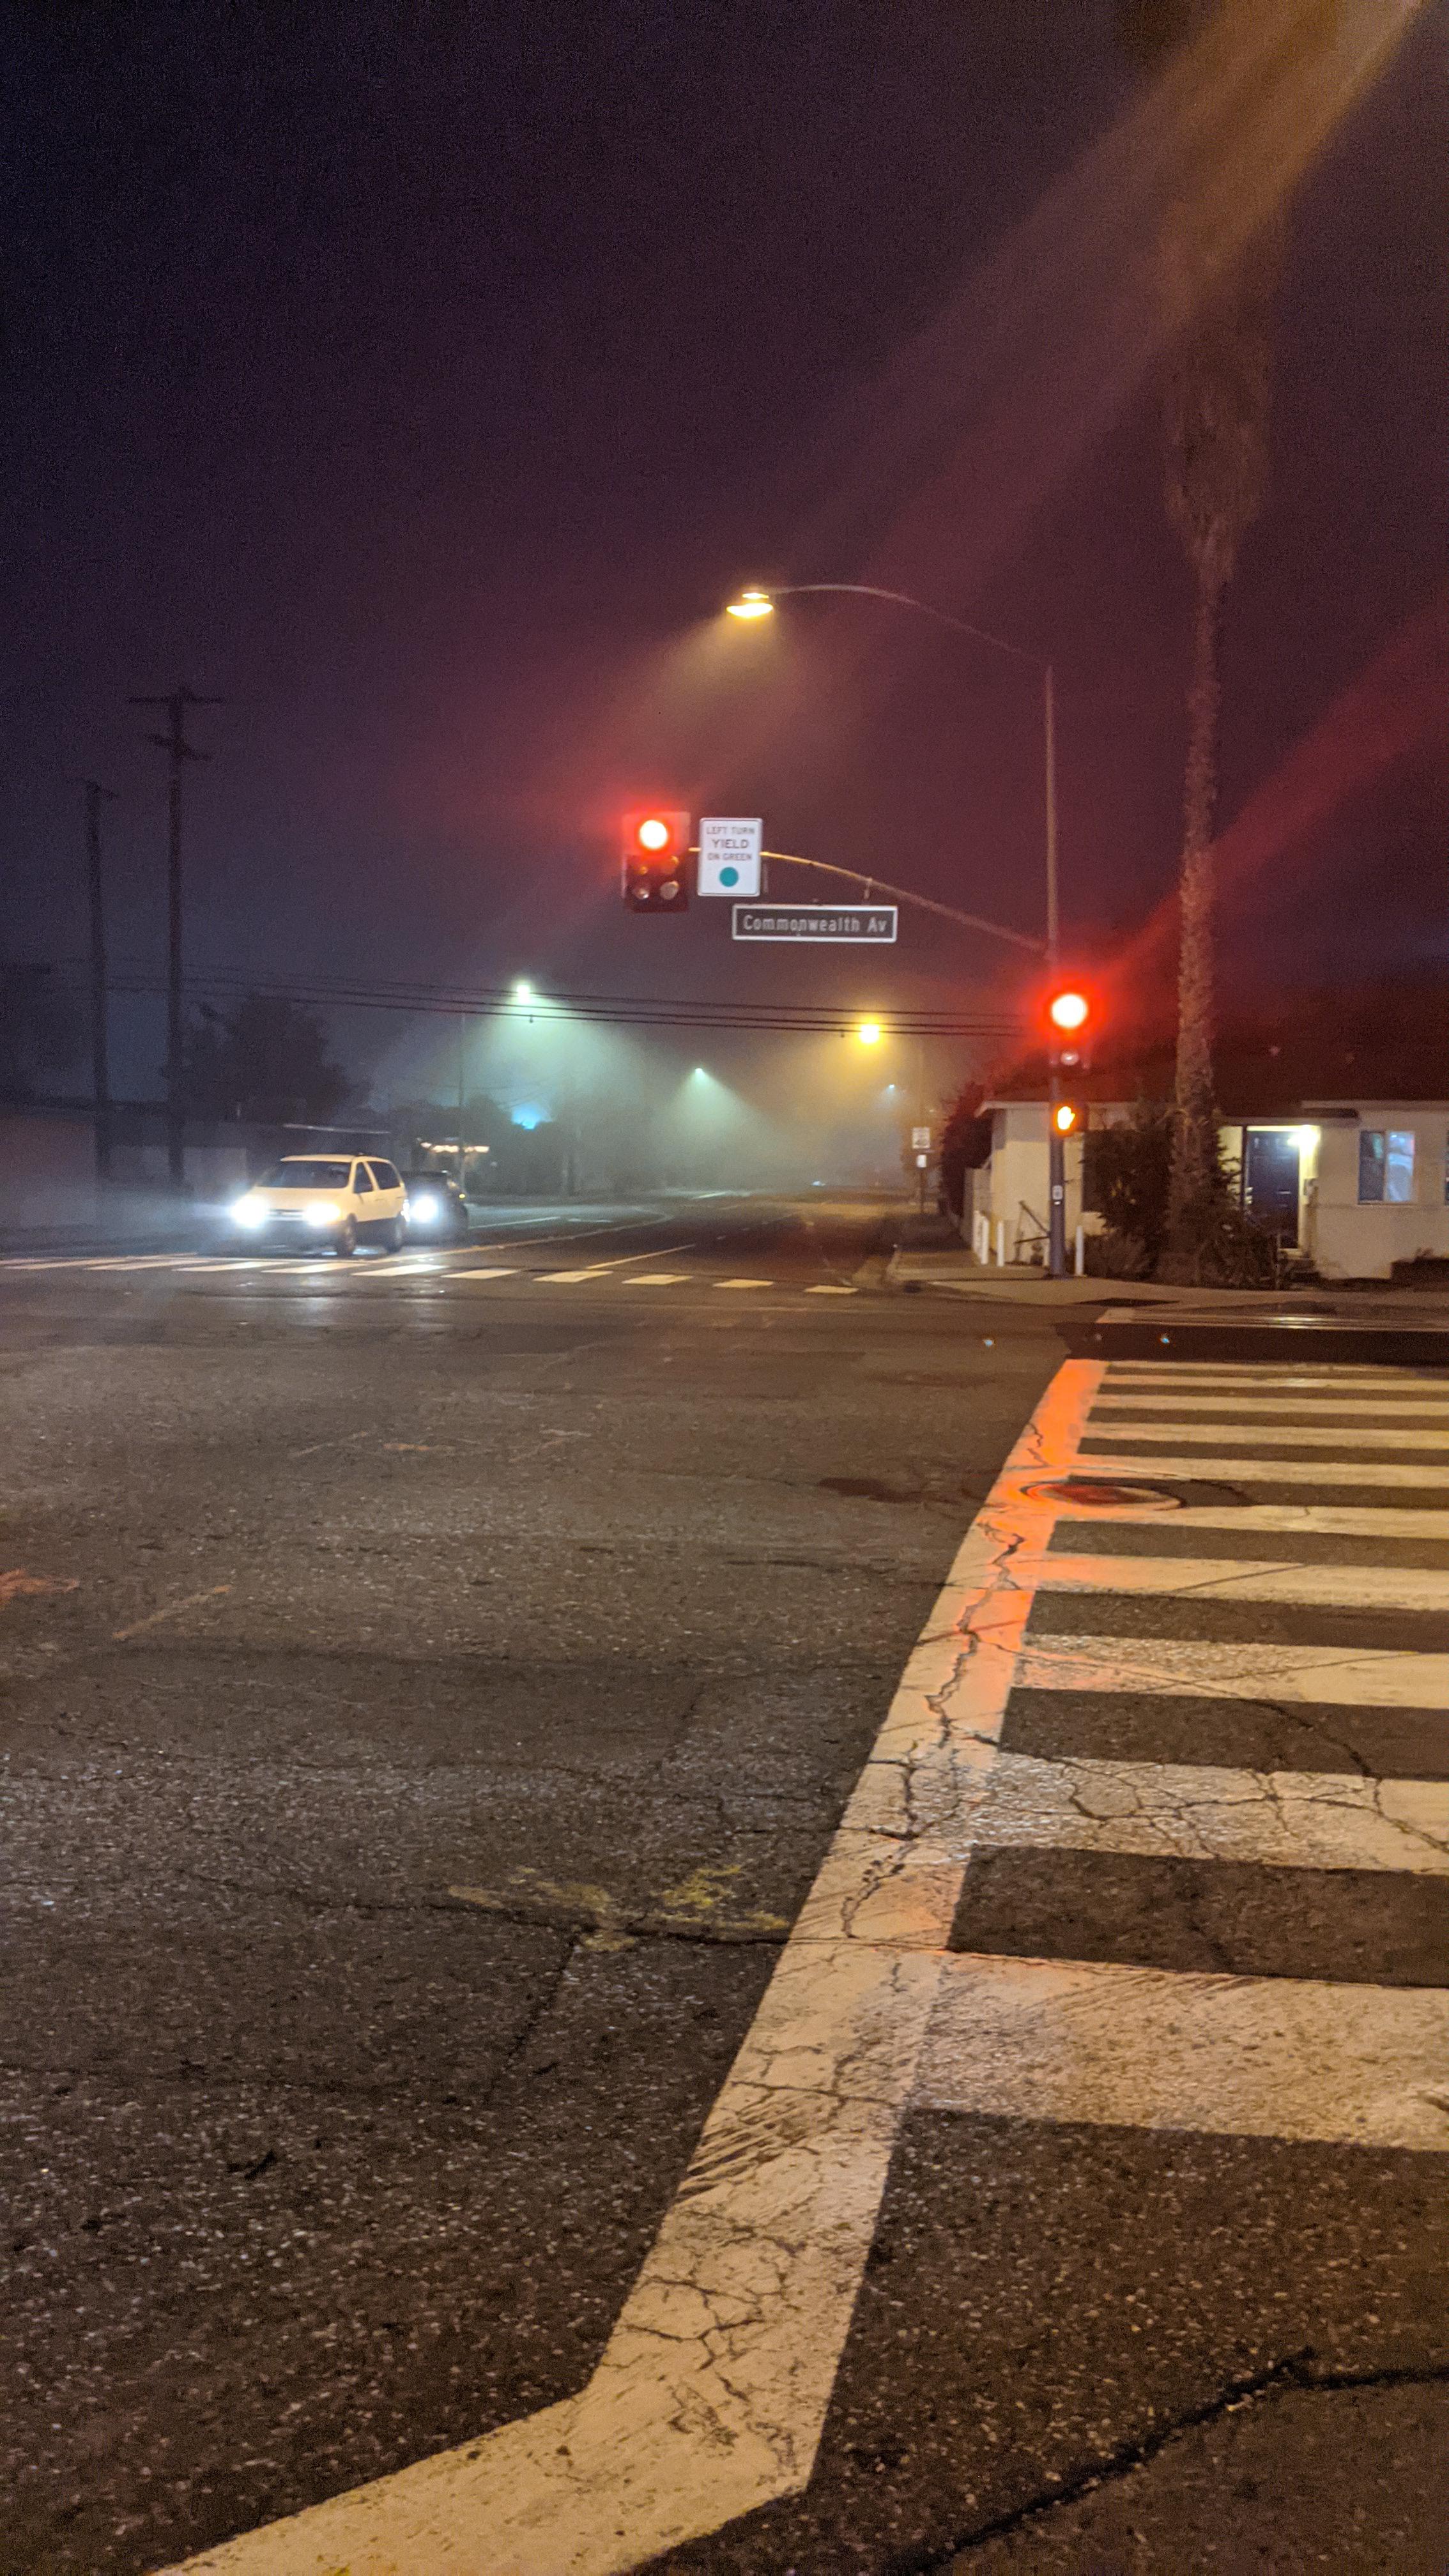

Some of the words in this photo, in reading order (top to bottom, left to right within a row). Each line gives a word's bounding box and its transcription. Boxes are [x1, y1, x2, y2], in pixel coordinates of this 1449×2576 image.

[707, 826, 726, 835] LEFT
[712, 839, 749, 849] YIELD
[743, 914, 861, 932] Commonwealth
[867, 917, 887, 932] Av
